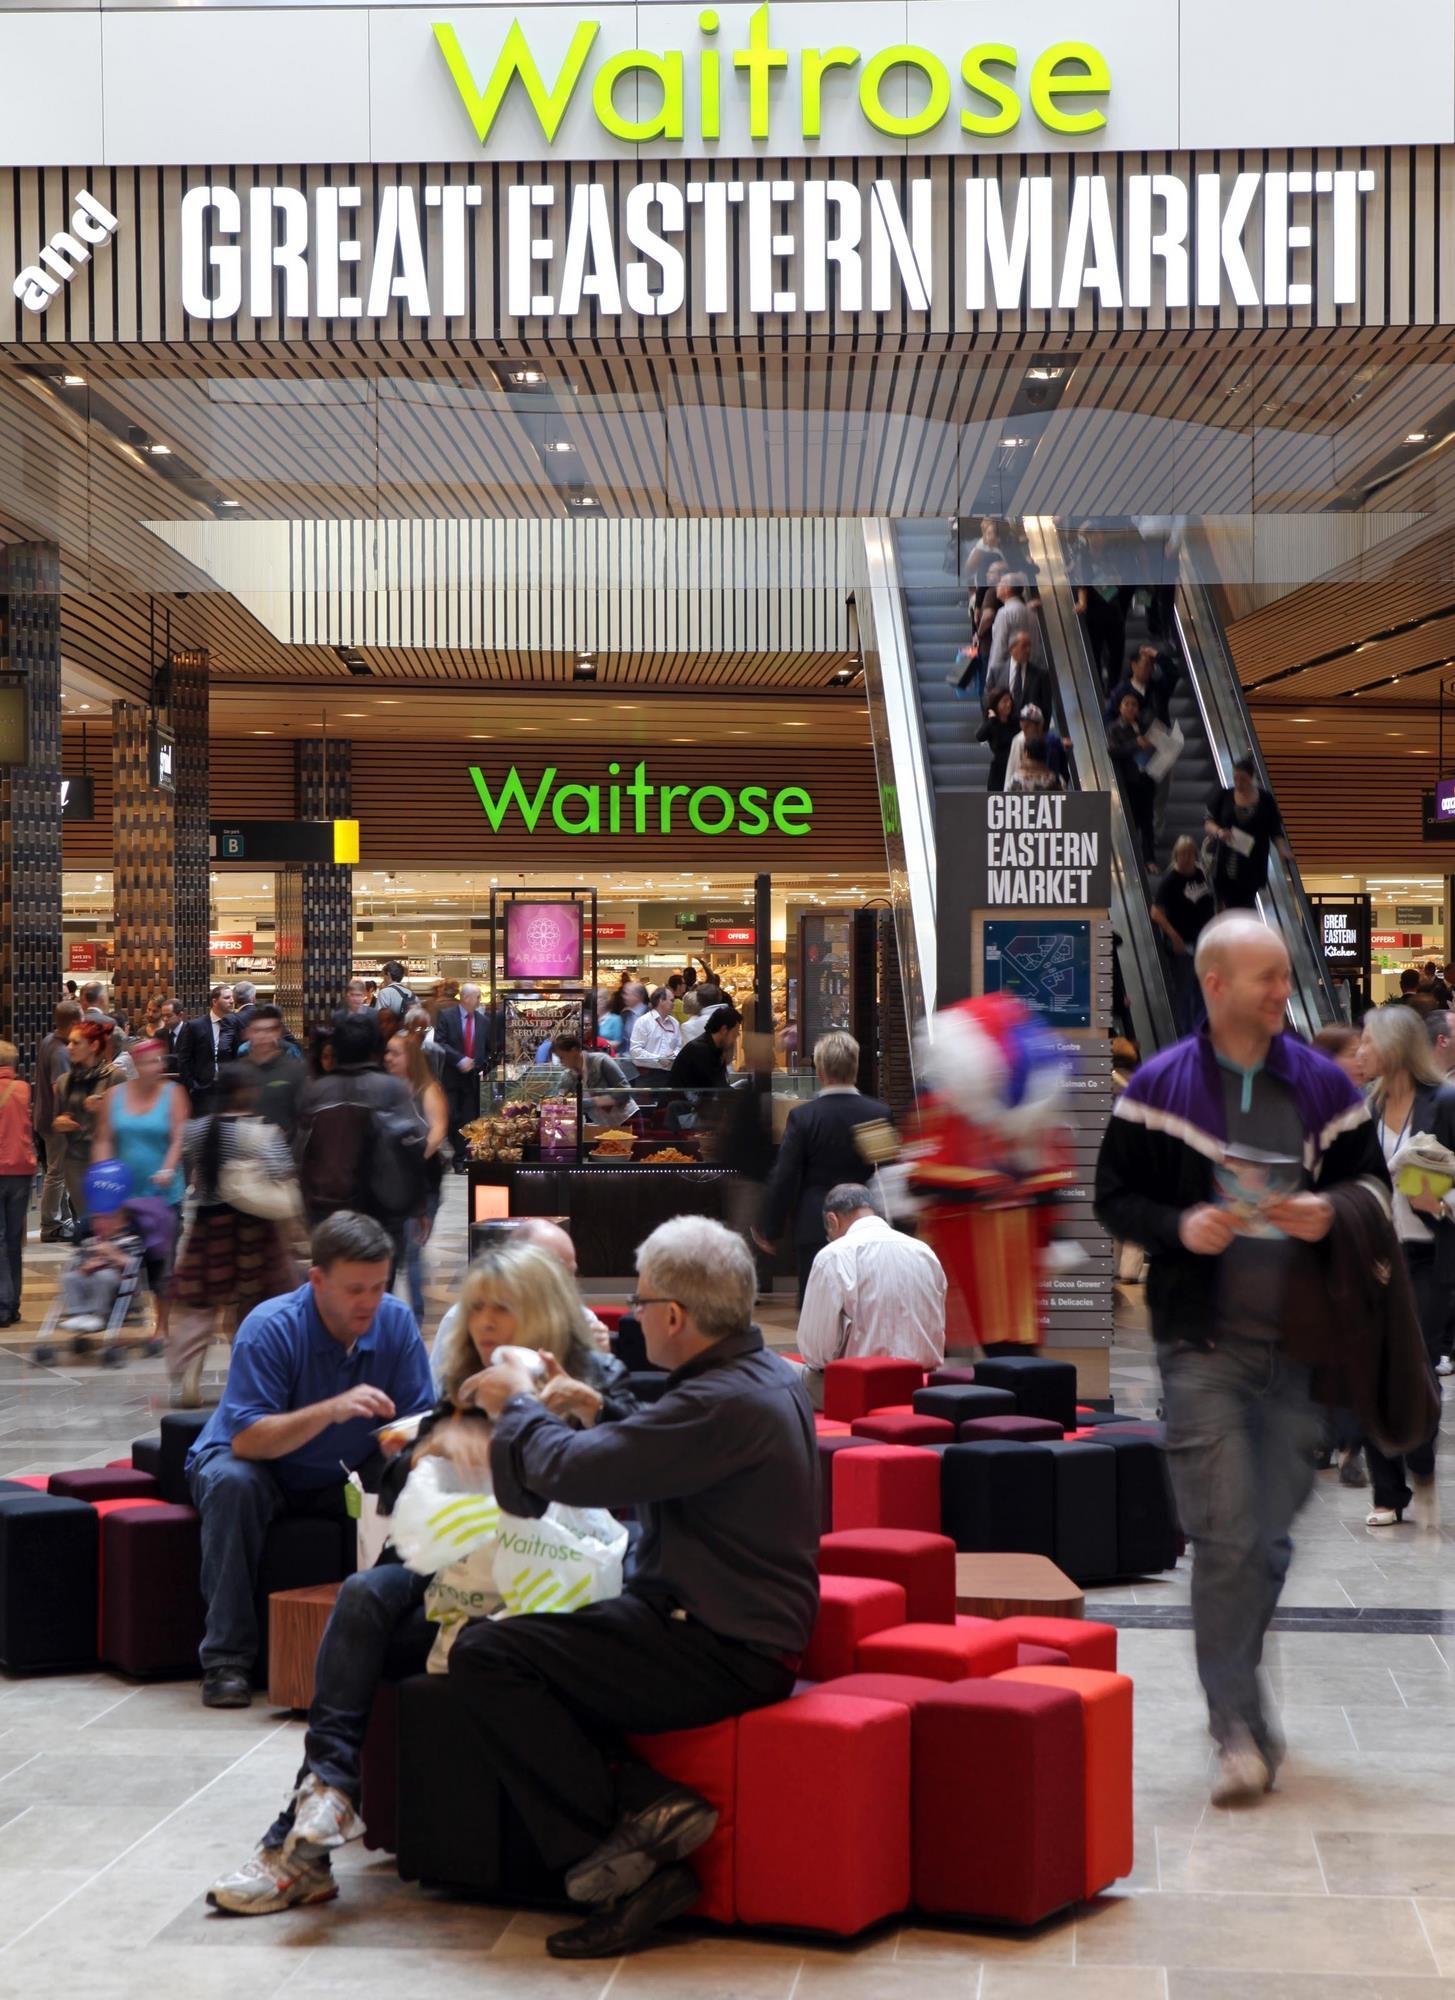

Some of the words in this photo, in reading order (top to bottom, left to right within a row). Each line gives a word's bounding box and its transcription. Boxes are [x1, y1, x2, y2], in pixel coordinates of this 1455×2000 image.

[430, 1, 1111, 147] Waitrose
[12, 189, 120, 314] and
[182, 185, 481, 319] GREAT
[508, 179, 931, 316] EASTERN
[966, 170, 1374, 310] MARKET
[469, 760, 813, 835] Waitrose
[987, 795, 1066, 829] GREAT
[229, 838, 239, 853] B
[988, 832, 1098, 867] EASTERN
[988, 870, 1092, 904] MARKET
[1324, 914, 1347, 928] GREAT
[1324, 930, 1356, 943] EASTERN
[513, 953, 573, 963] ARABELLA
[1324, 945, 1357, 957] Kitchen
[526, 1010, 565, 1018] FRESHLY
[513, 1029, 547, 1037] SERVED
[1087, 1080, 1098, 1088] Co
[1053, 1280, 1075, 1288] Cocoa
[1076, 1280, 1101, 1288] Grower
[1058, 1298, 1094, 1306] Delicacies
[496, 1530, 584, 1562] Waitrose
